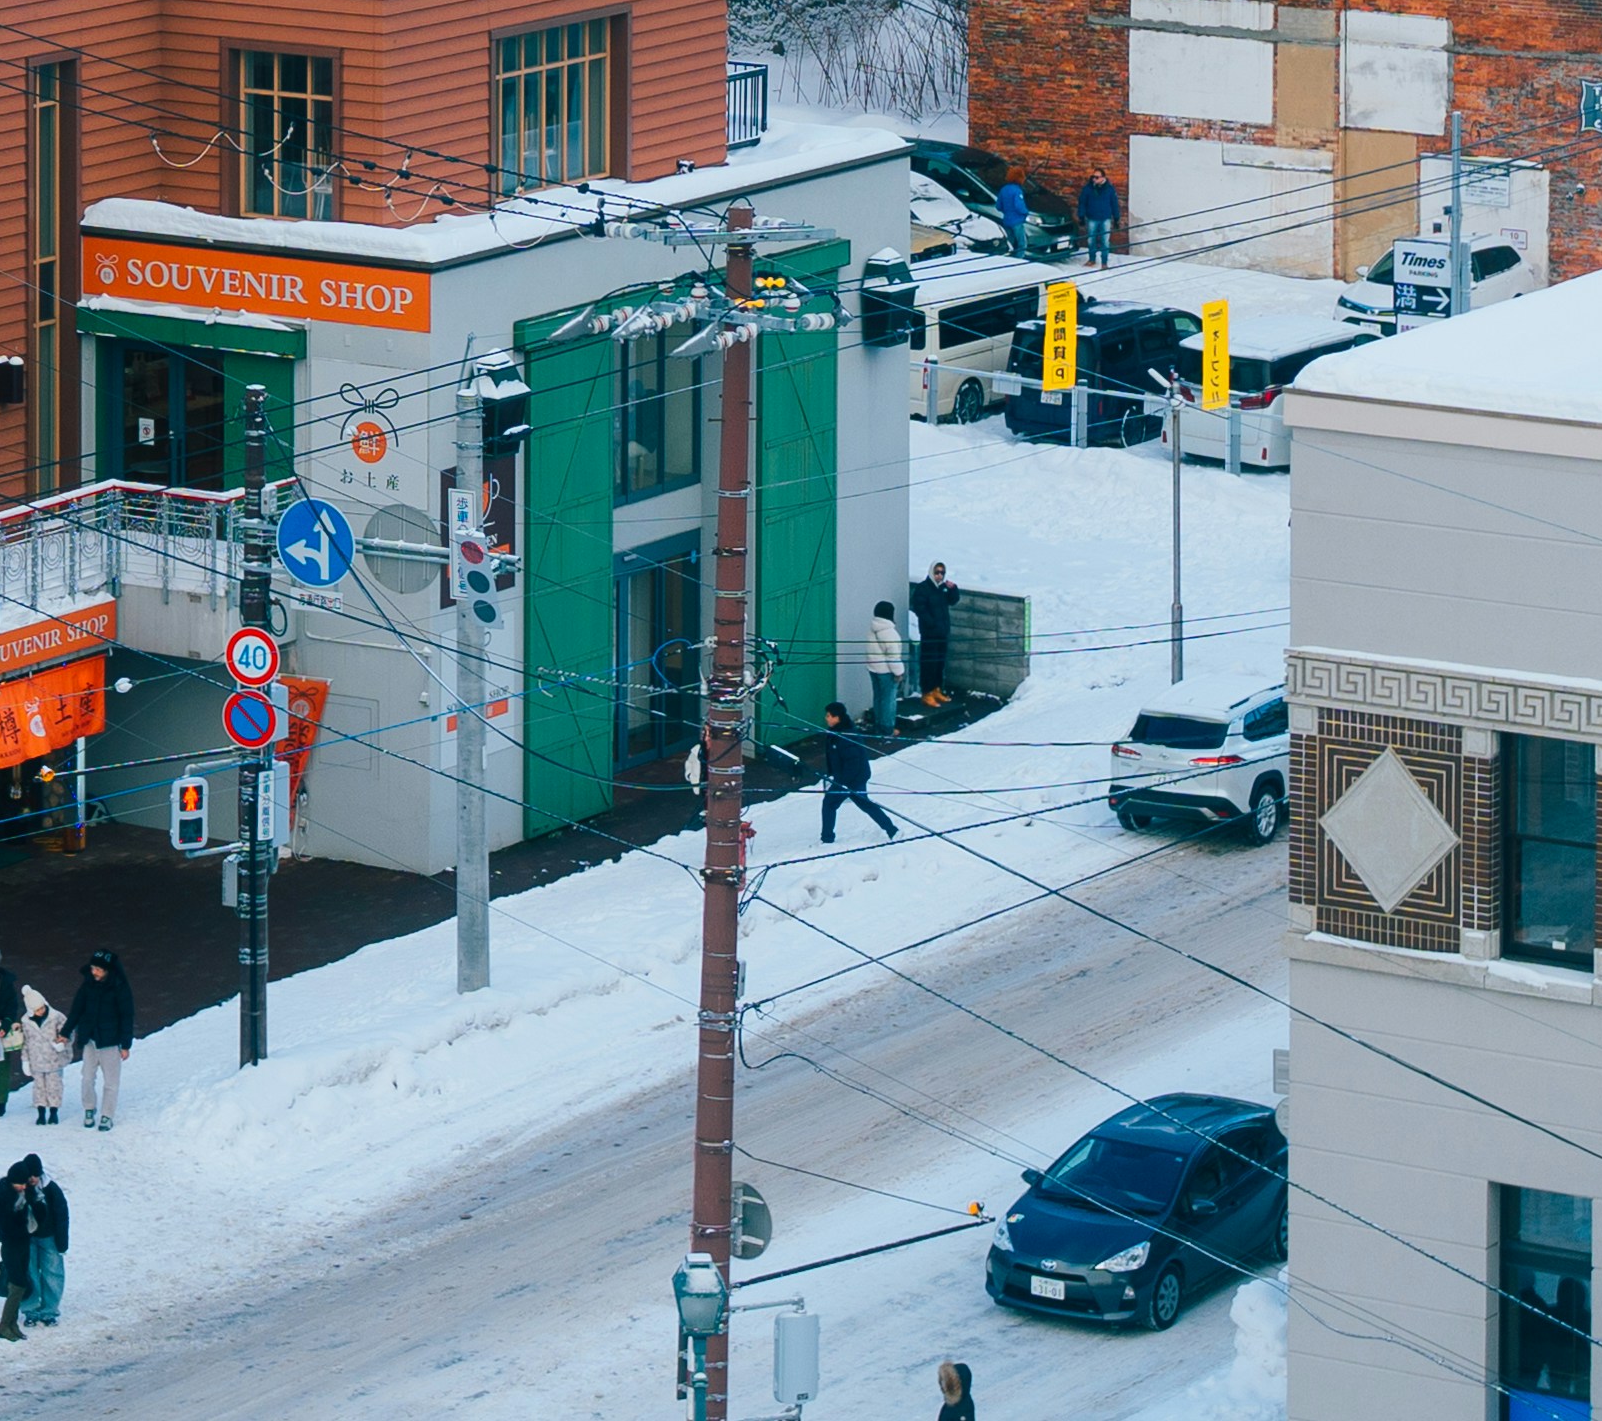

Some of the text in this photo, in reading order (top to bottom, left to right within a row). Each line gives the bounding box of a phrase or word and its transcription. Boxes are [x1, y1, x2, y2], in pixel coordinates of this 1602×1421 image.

[1401, 251, 1446, 270] Times
[1409, 269, 1439, 279] PARKING
[126, 258, 414, 315] SOUVENIR SHOP
[1396, 284, 1416, 309] 満
[340, 468, 400, 491] お土産
[67, 615, 108, 643] SHOP
[238, 644, 267, 671] 40
[489, 685, 510, 699] SHOP
